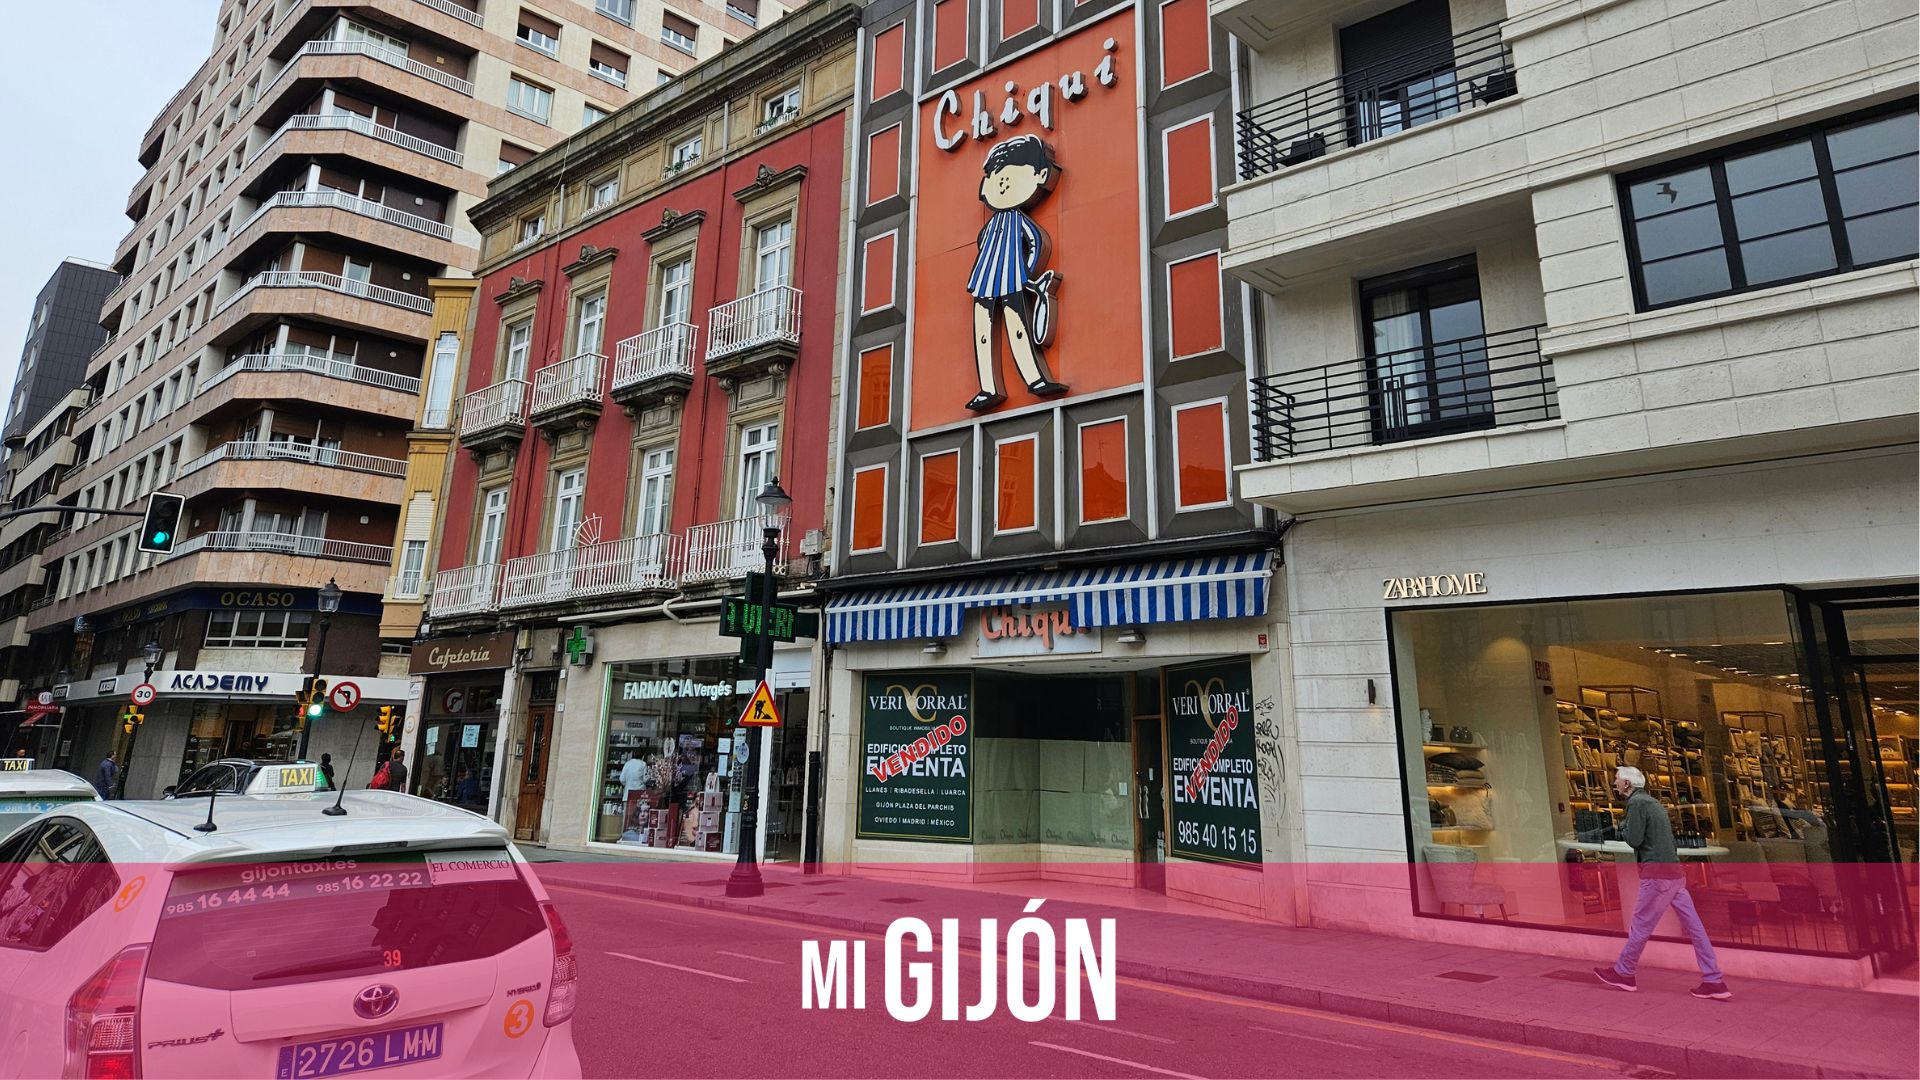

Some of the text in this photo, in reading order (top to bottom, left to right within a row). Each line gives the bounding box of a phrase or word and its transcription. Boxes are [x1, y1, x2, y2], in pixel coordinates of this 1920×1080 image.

[934, 37, 1118, 151] Chiqui
[220, 592, 295, 607] OCASO
[981, 603, 1086, 650] Chiqu
[428, 646, 490, 669] Cafetería
[170, 674, 269, 691] ACADEMY
[623, 679, 695, 700] FARMACIA
[136, 690, 151, 699] 30
[871, 714, 967, 783] VENDIDO
[1186, 705, 1239, 800] VENDIDO
[4, 760, 28, 771] TAXI
[897, 756, 966, 778] VENTA
[1174, 757, 1253, 774] EDIFIC OMPLETO
[281, 768, 314, 786] TAXI
[893, 787, 935, 795] RIBADESELLA
[1174, 775, 1195, 804] EN
[1200, 776, 1258, 809] VENTA
[25, 802, 42, 812] 16
[927, 803, 955, 811] PARCHIS
[875, 816, 897, 824] OVIEDO
[930, 818, 955, 827] MÉXICO
[1178, 820, 1257, 854] 985 40 15 15
[241, 859, 357, 883] gijontaxi.es
[431, 859, 510, 873] EL COMERCIO
[316, 872, 423, 894] 985 16 22 22
[167, 883, 290, 915] 985 16 44 44
[383, 950, 402, 967] 39
[508, 1002, 530, 1035] 3
[298, 1037, 374, 1077] 2726
[280, 1068, 288, 1078] E
